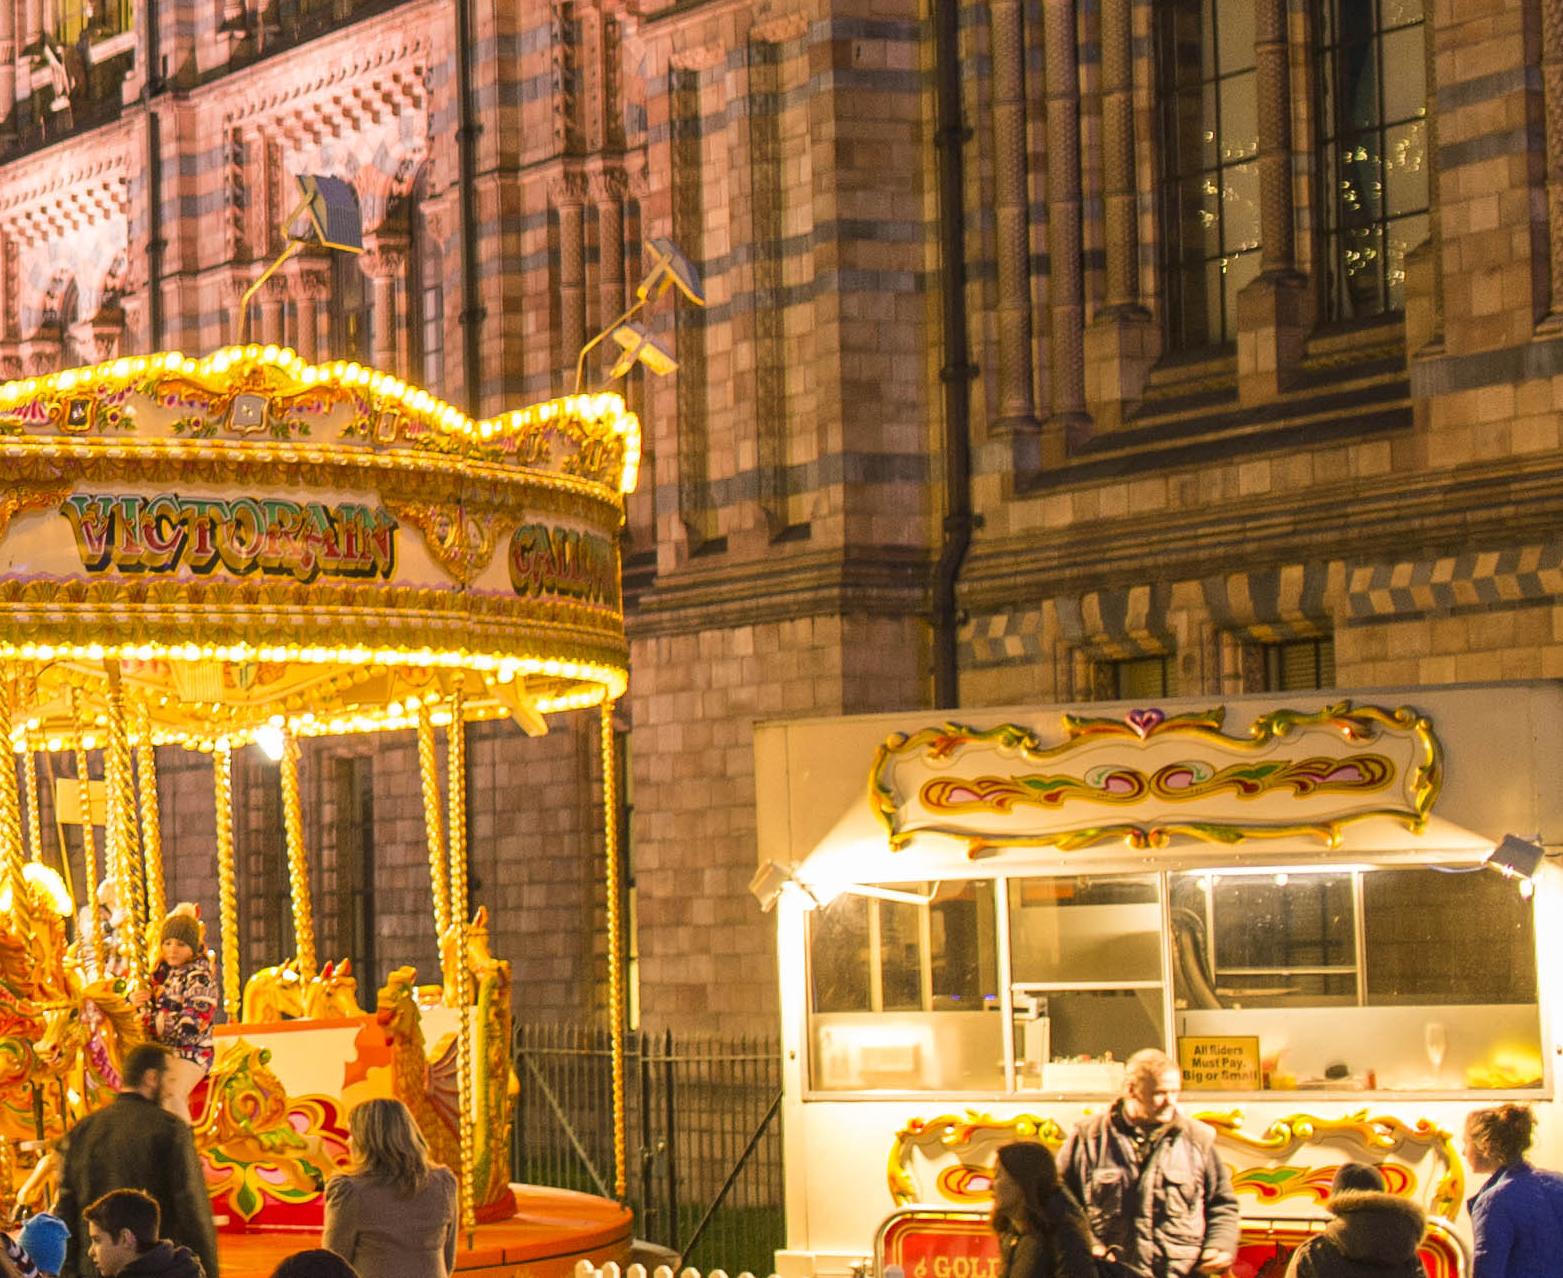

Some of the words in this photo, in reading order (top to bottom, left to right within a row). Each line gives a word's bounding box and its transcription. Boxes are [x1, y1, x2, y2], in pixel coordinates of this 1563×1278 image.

[60, 492, 398, 582] VICTORAIN
[1194, 1045, 1208, 1055] All
[1192, 1058, 1219, 1068] Must
[1183, 1070, 1203, 1083] Big
[1205, 1072, 1218, 1080] or
